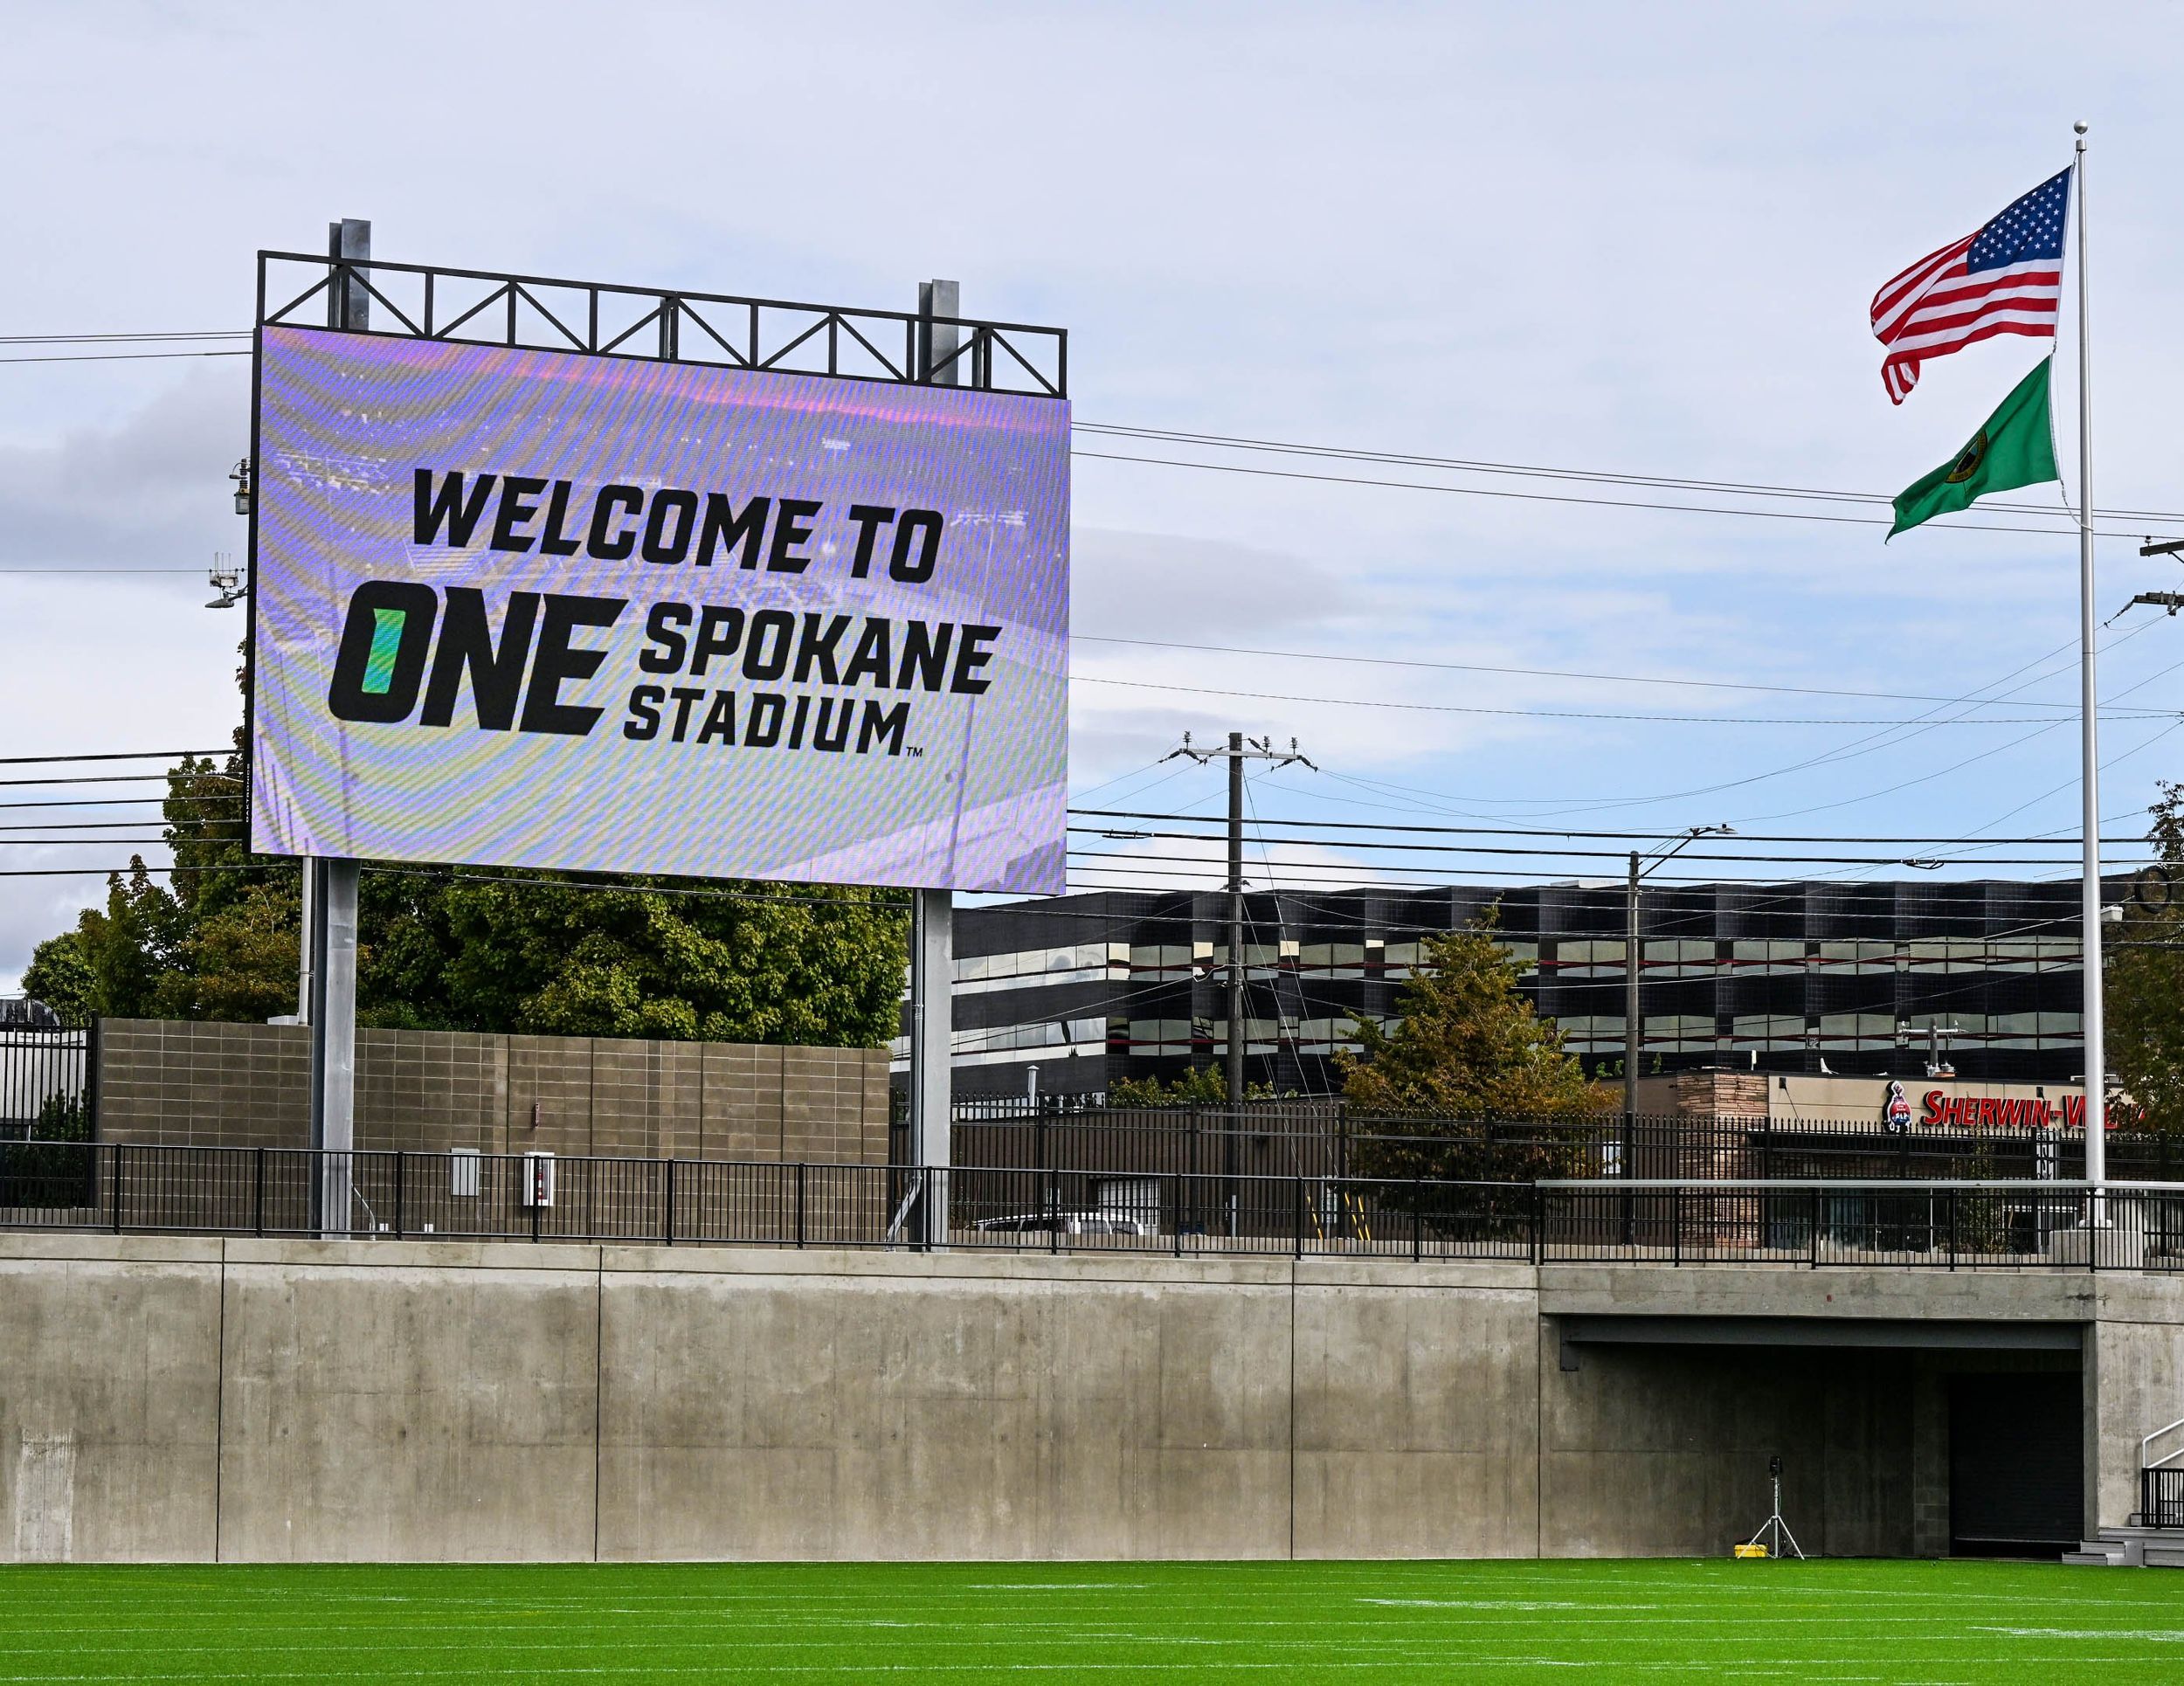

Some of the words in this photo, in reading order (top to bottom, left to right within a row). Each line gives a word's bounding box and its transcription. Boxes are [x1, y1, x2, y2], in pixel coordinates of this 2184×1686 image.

[413, 468, 824, 574] WELCOME
[848, 504, 943, 584] TO
[328, 580, 630, 736] ONE
[639, 601, 1003, 695] SPOKANE
[623, 685, 911, 757] STADIUM
